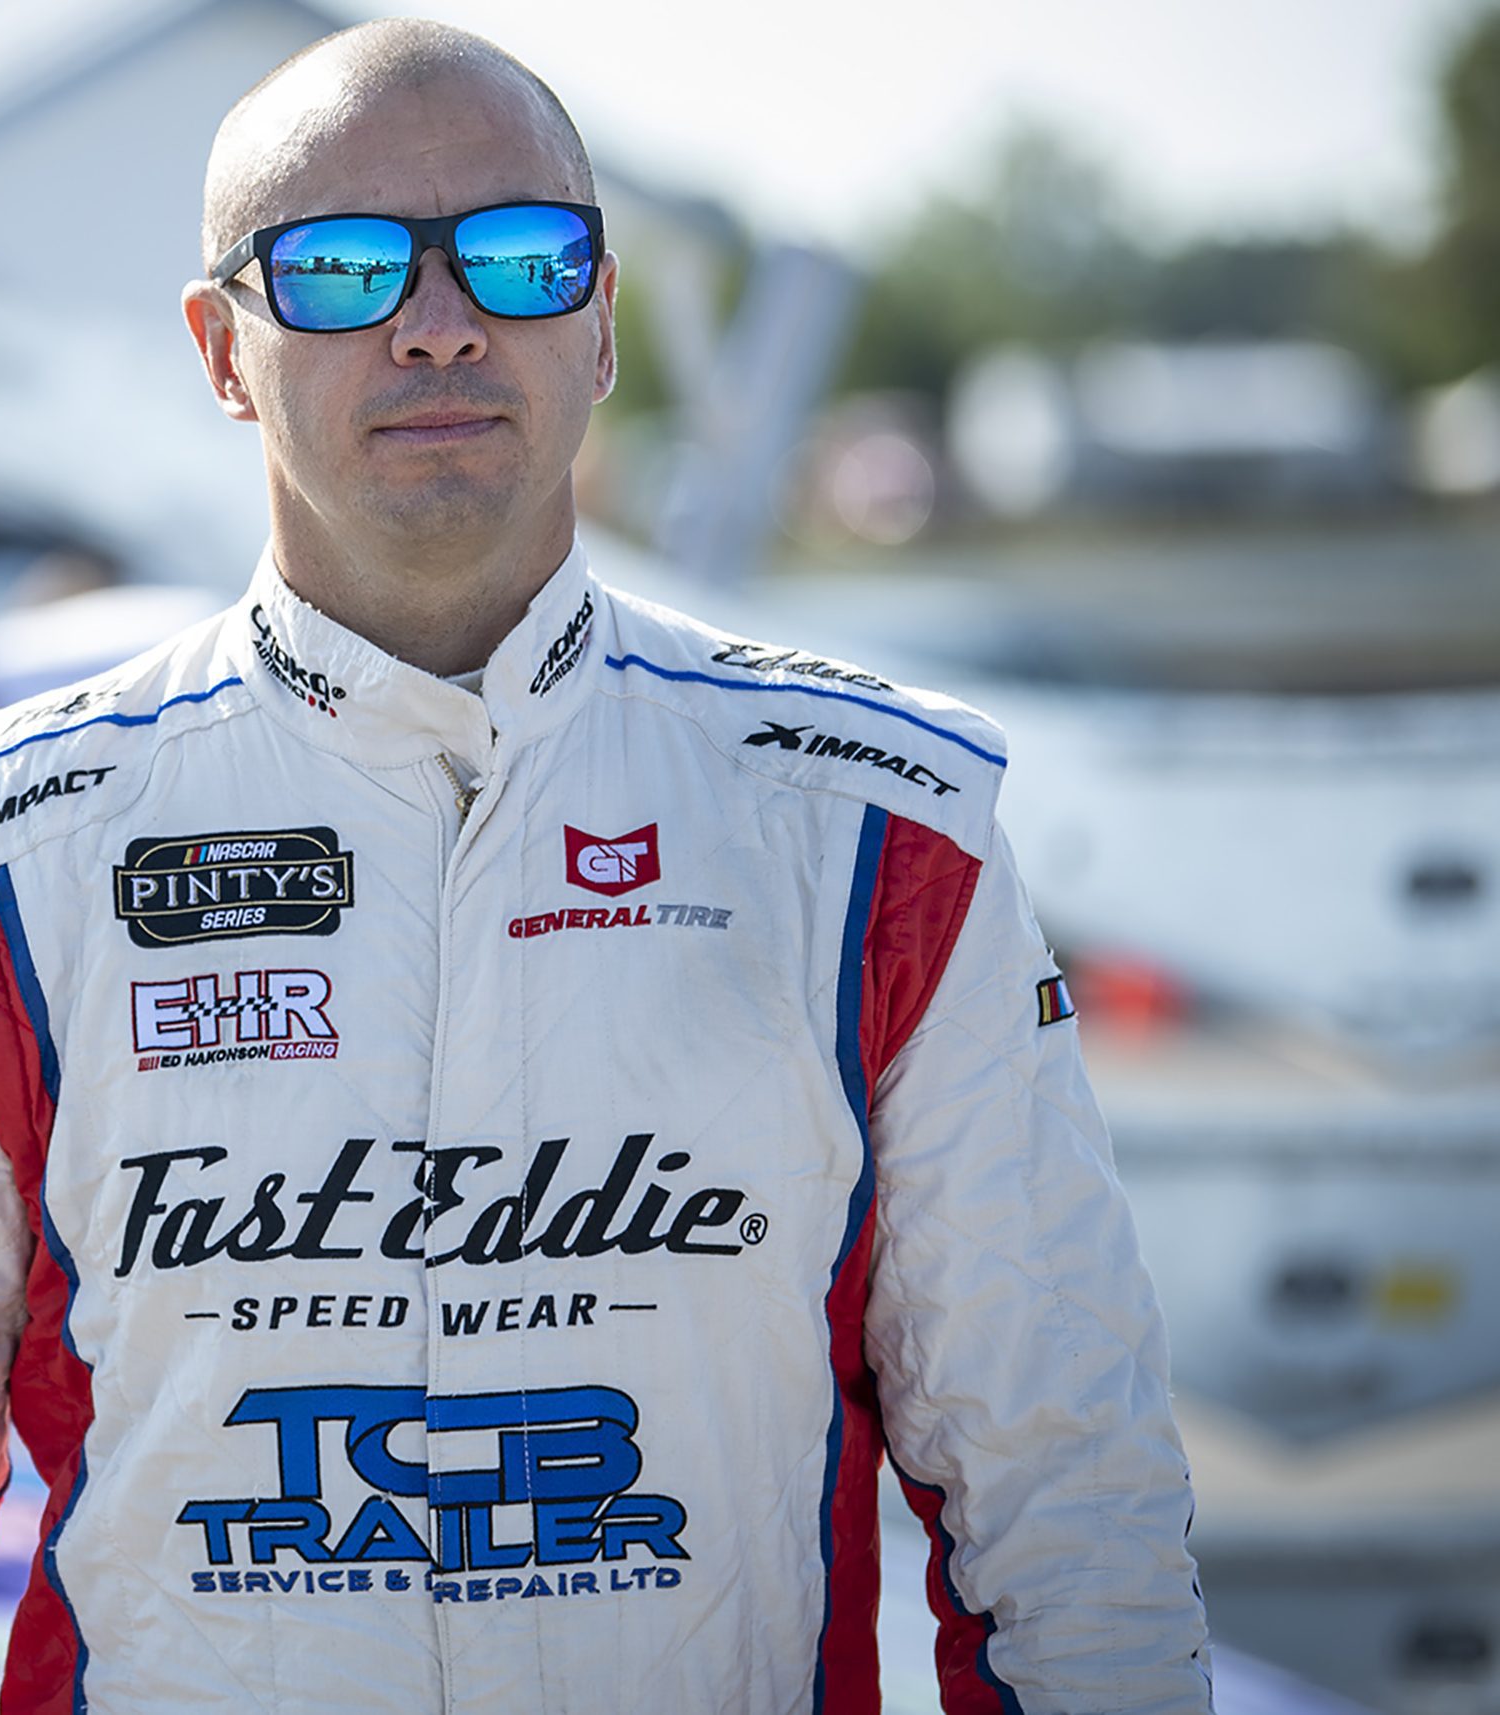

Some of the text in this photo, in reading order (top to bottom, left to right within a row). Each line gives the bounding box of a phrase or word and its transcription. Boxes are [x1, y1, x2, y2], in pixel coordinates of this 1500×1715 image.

[804, 734, 961, 797] IMPACT
[206, 841, 277, 863] NASCAR
[576, 841, 649, 884] GT
[200, 907, 266, 930] SERIES
[507, 903, 733, 939] GENERAL TIRE
[131, 969, 339, 1053] EHR
[160, 1042, 337, 1069] ED HAKONSON RACING
[113, 1137, 377, 1278] Fast
[231, 1292, 597, 1337] SPEED WEAR
[222, 1384, 643, 1506] TCB
[176, 1494, 692, 1574] TRAILER
[191, 1566, 682, 1604] SERVICE & REPAIR LTD
